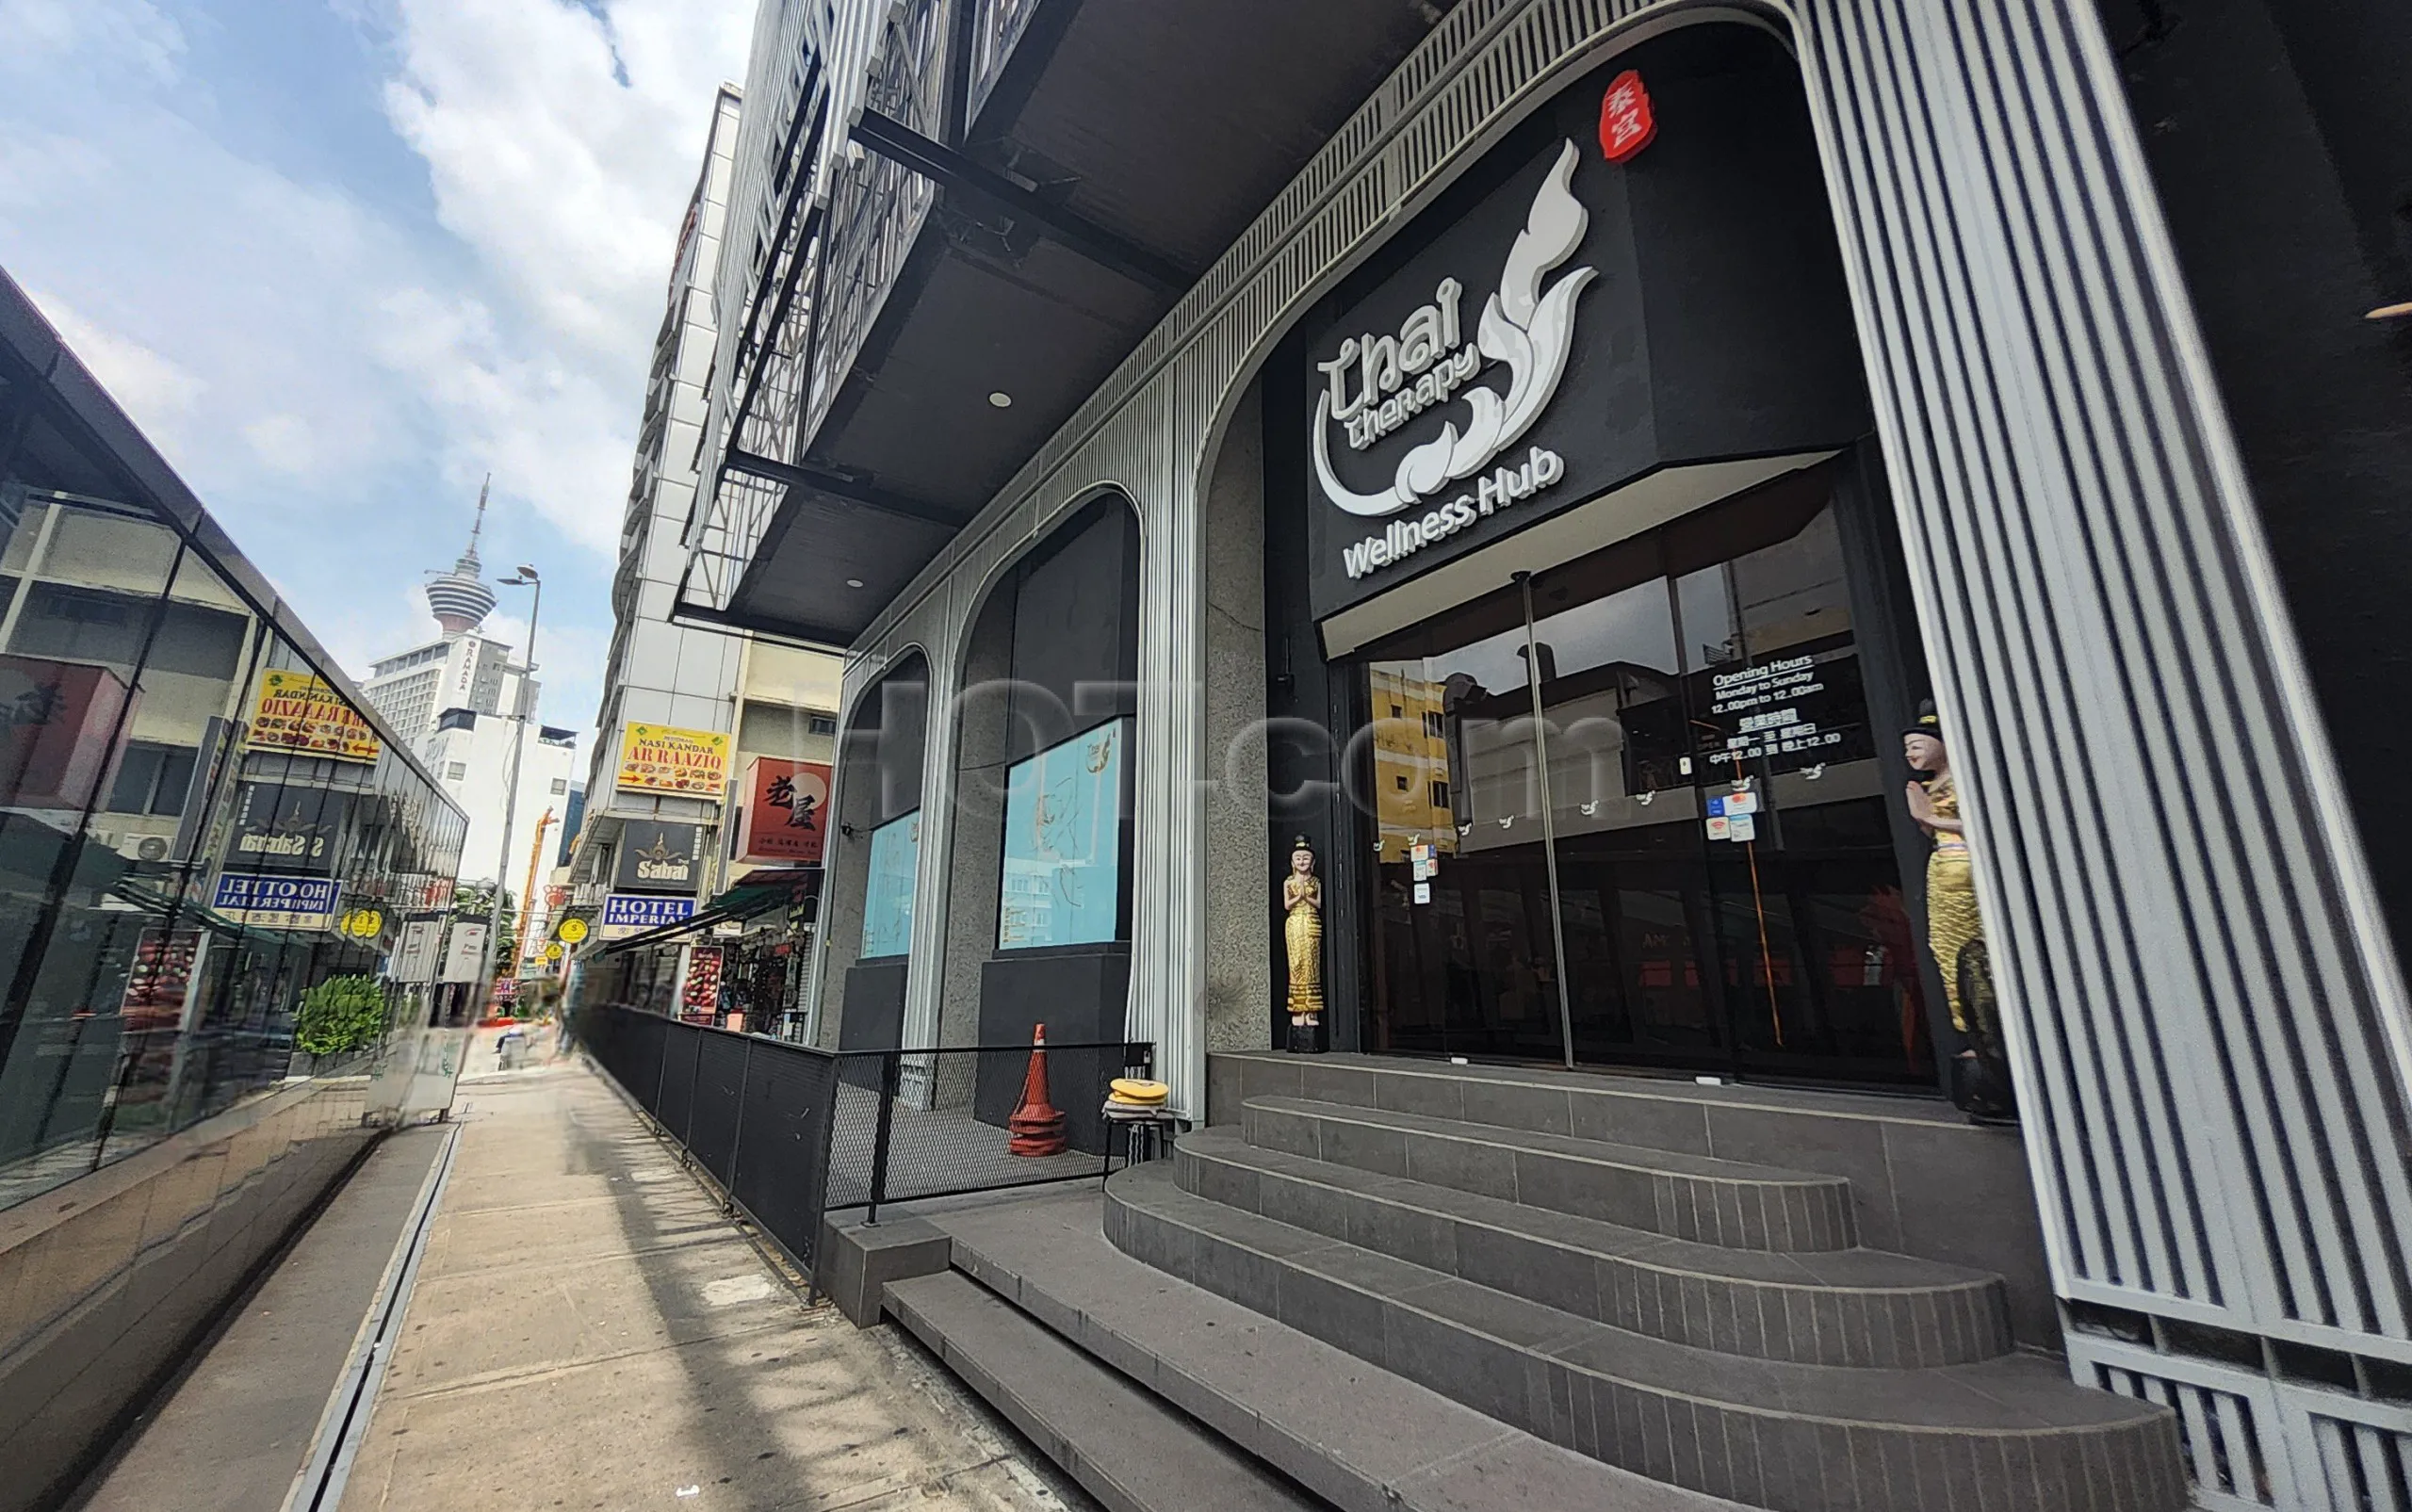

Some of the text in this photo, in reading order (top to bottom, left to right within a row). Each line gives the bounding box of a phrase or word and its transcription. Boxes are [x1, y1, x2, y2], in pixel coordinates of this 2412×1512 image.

[1343, 446, 1565, 579] Wellness Hub
[1712, 655, 1813, 687] Opening Hours
[1715, 671, 1815, 701] Monday to Sunday
[1758, 694, 1772, 704] to
[627, 746, 653, 762] AR
[639, 738, 714, 755] NASI KANDAR
[610, 899, 689, 916] HOTEL
[608, 913, 684, 925] IMPERIA
